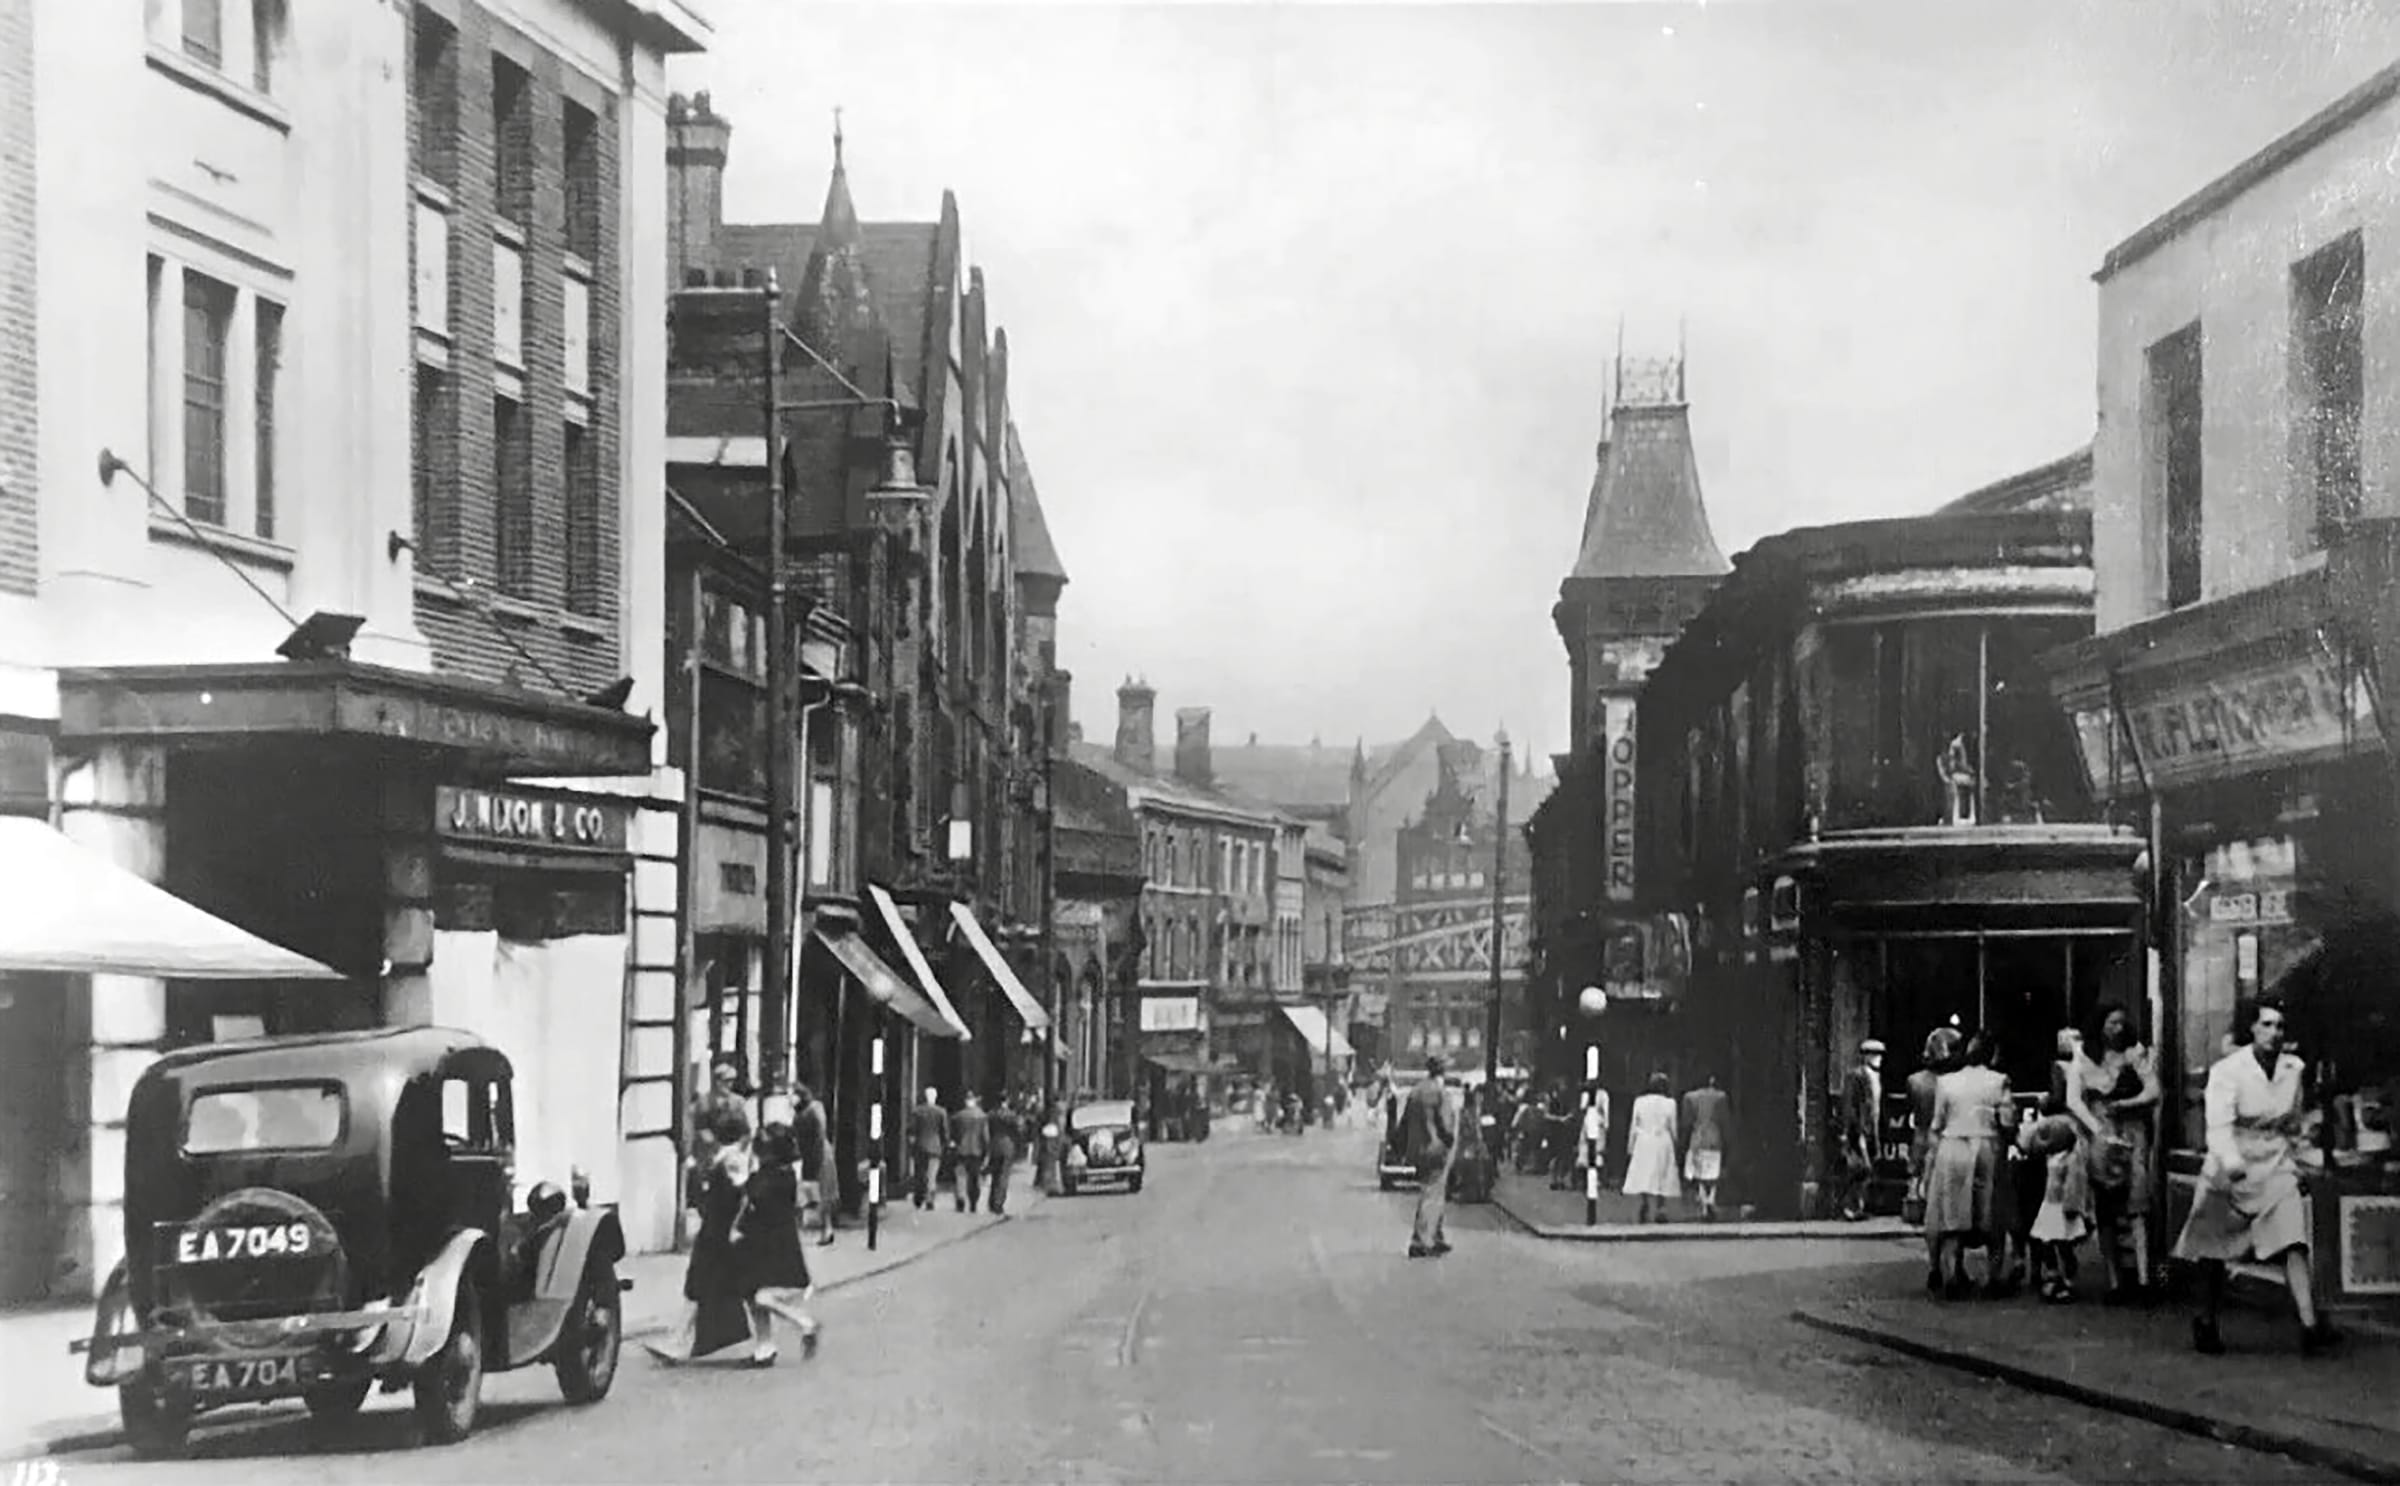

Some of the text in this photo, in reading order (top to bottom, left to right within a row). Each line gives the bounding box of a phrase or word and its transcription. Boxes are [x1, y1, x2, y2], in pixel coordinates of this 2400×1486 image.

[179, 1223, 310, 1263] EA 7049
[192, 1357, 300, 1389] EA 704
